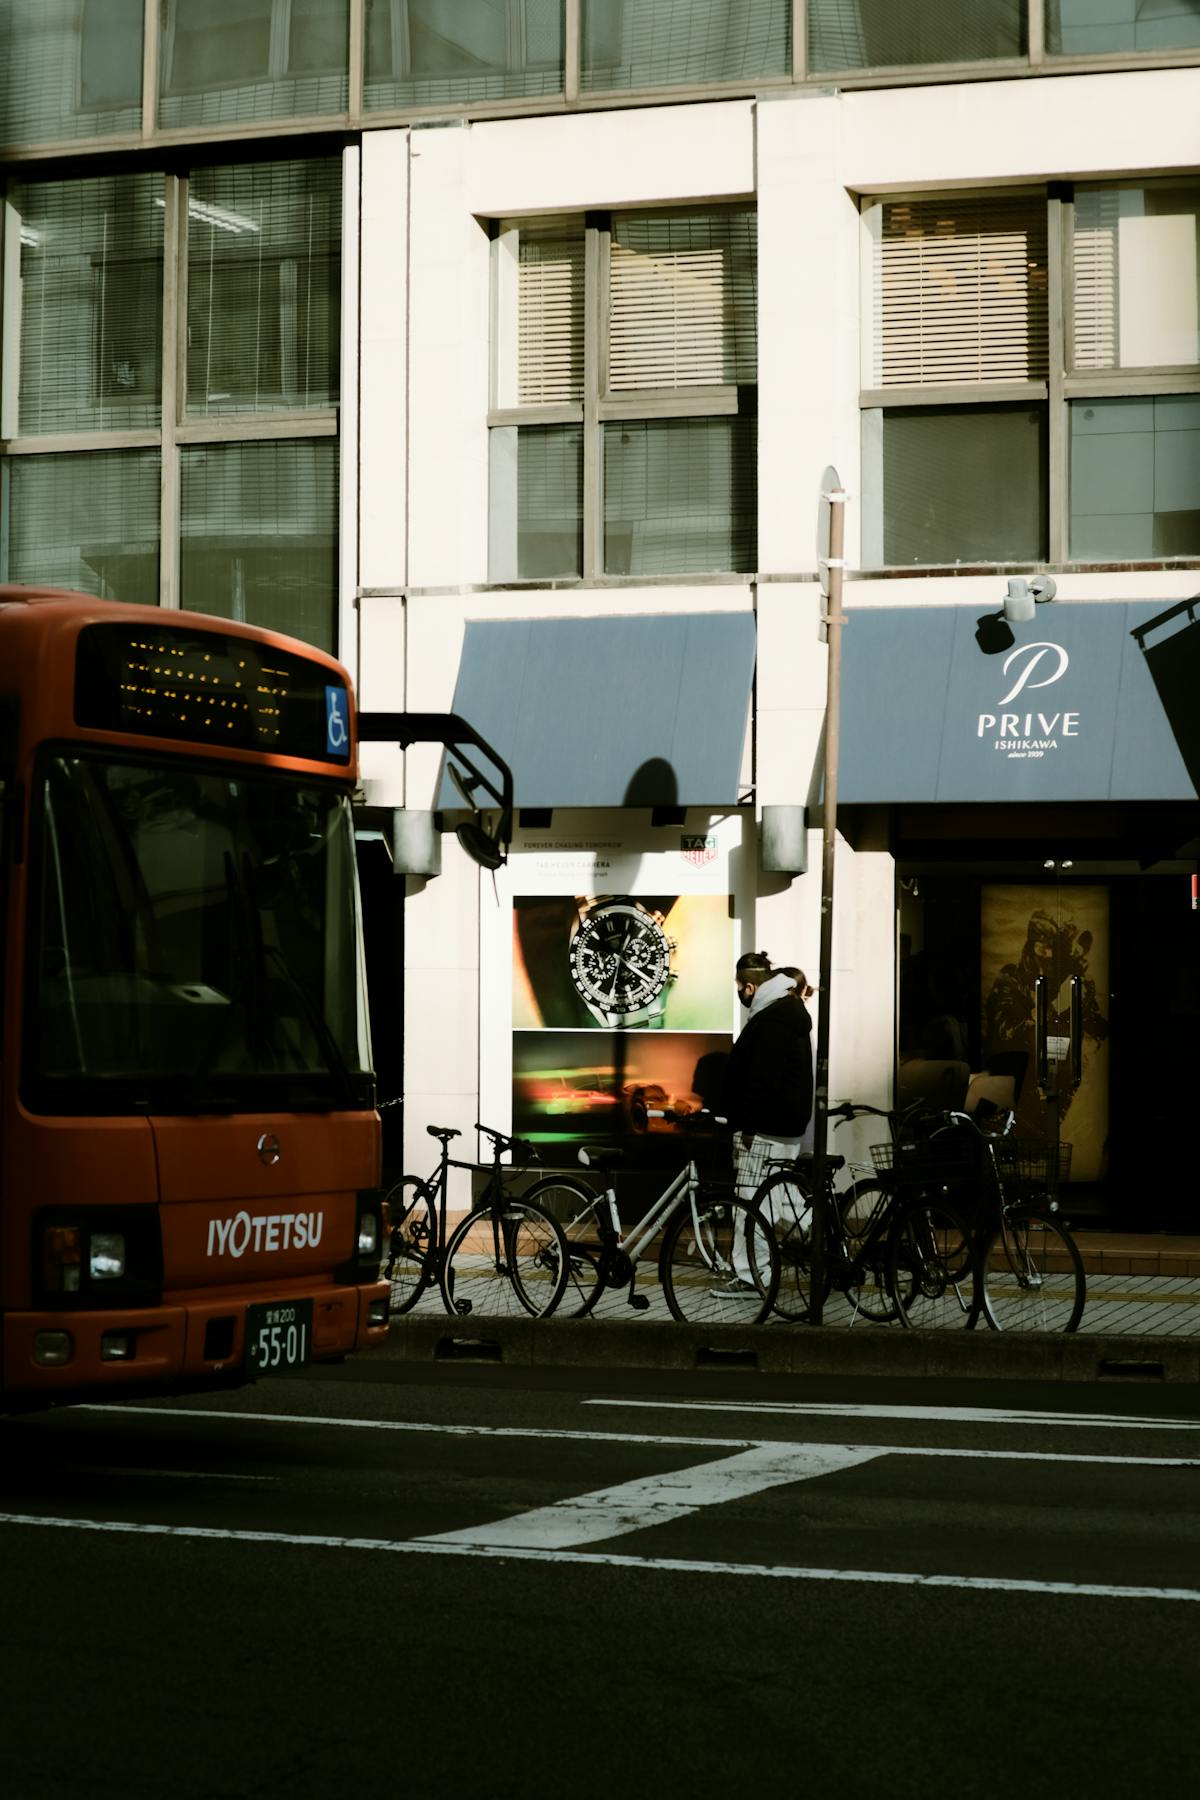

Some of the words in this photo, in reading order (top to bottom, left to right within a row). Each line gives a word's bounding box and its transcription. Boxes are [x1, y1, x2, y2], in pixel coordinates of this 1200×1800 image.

[977, 712, 1080, 737] PRIVE
[994, 739, 1058, 750] ISHIKAWA
[686, 838, 715, 848] TAG
[207, 1211, 323, 1258] IYOTETSU
